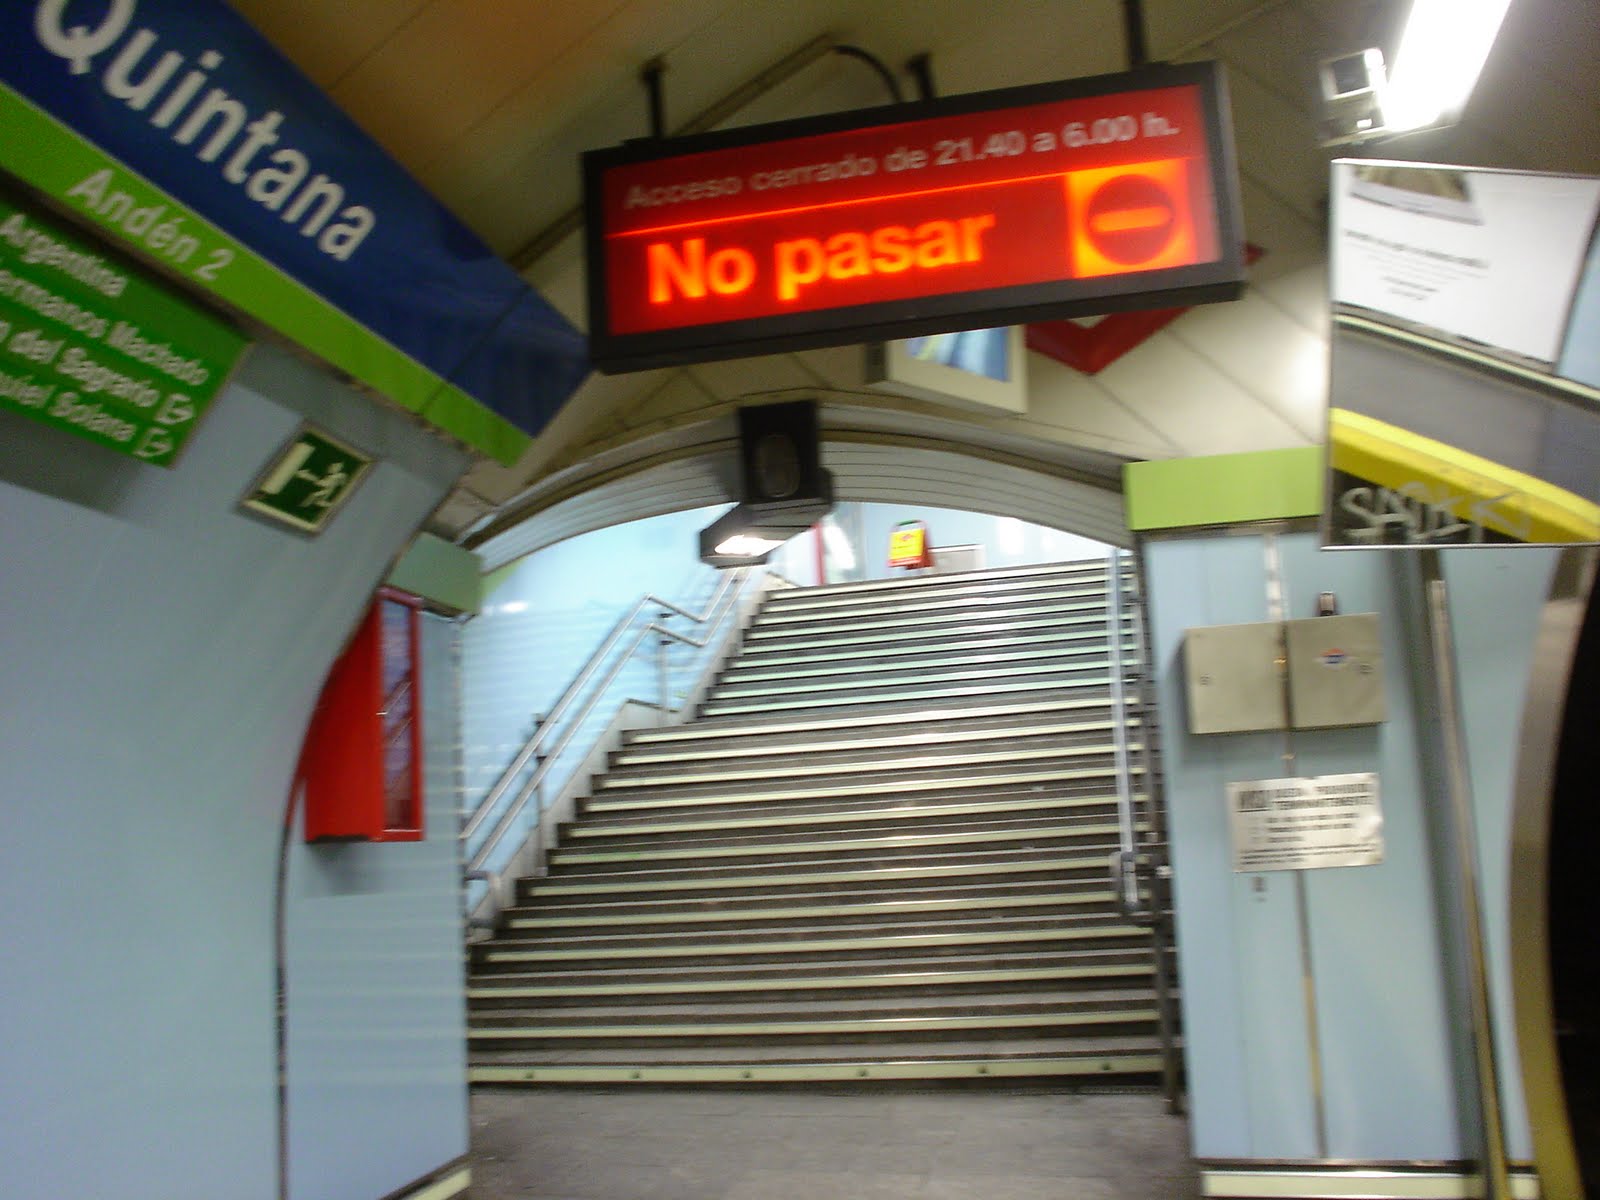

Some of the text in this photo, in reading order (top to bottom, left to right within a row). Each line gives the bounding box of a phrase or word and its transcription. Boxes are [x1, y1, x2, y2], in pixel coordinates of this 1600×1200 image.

[34, 0, 376, 262] Quintana
[624, 111, 1182, 210] Acceso cerrado de 21.40 a 6.00 h.
[66, 169, 235, 281] Andén 2
[648, 212, 996, 304] No pasar
[8, 329, 66, 365] del
[56, 347, 161, 408] Sagrario
[106, 321, 209, 386] Machado
[49, 391, 138, 443] Solana
